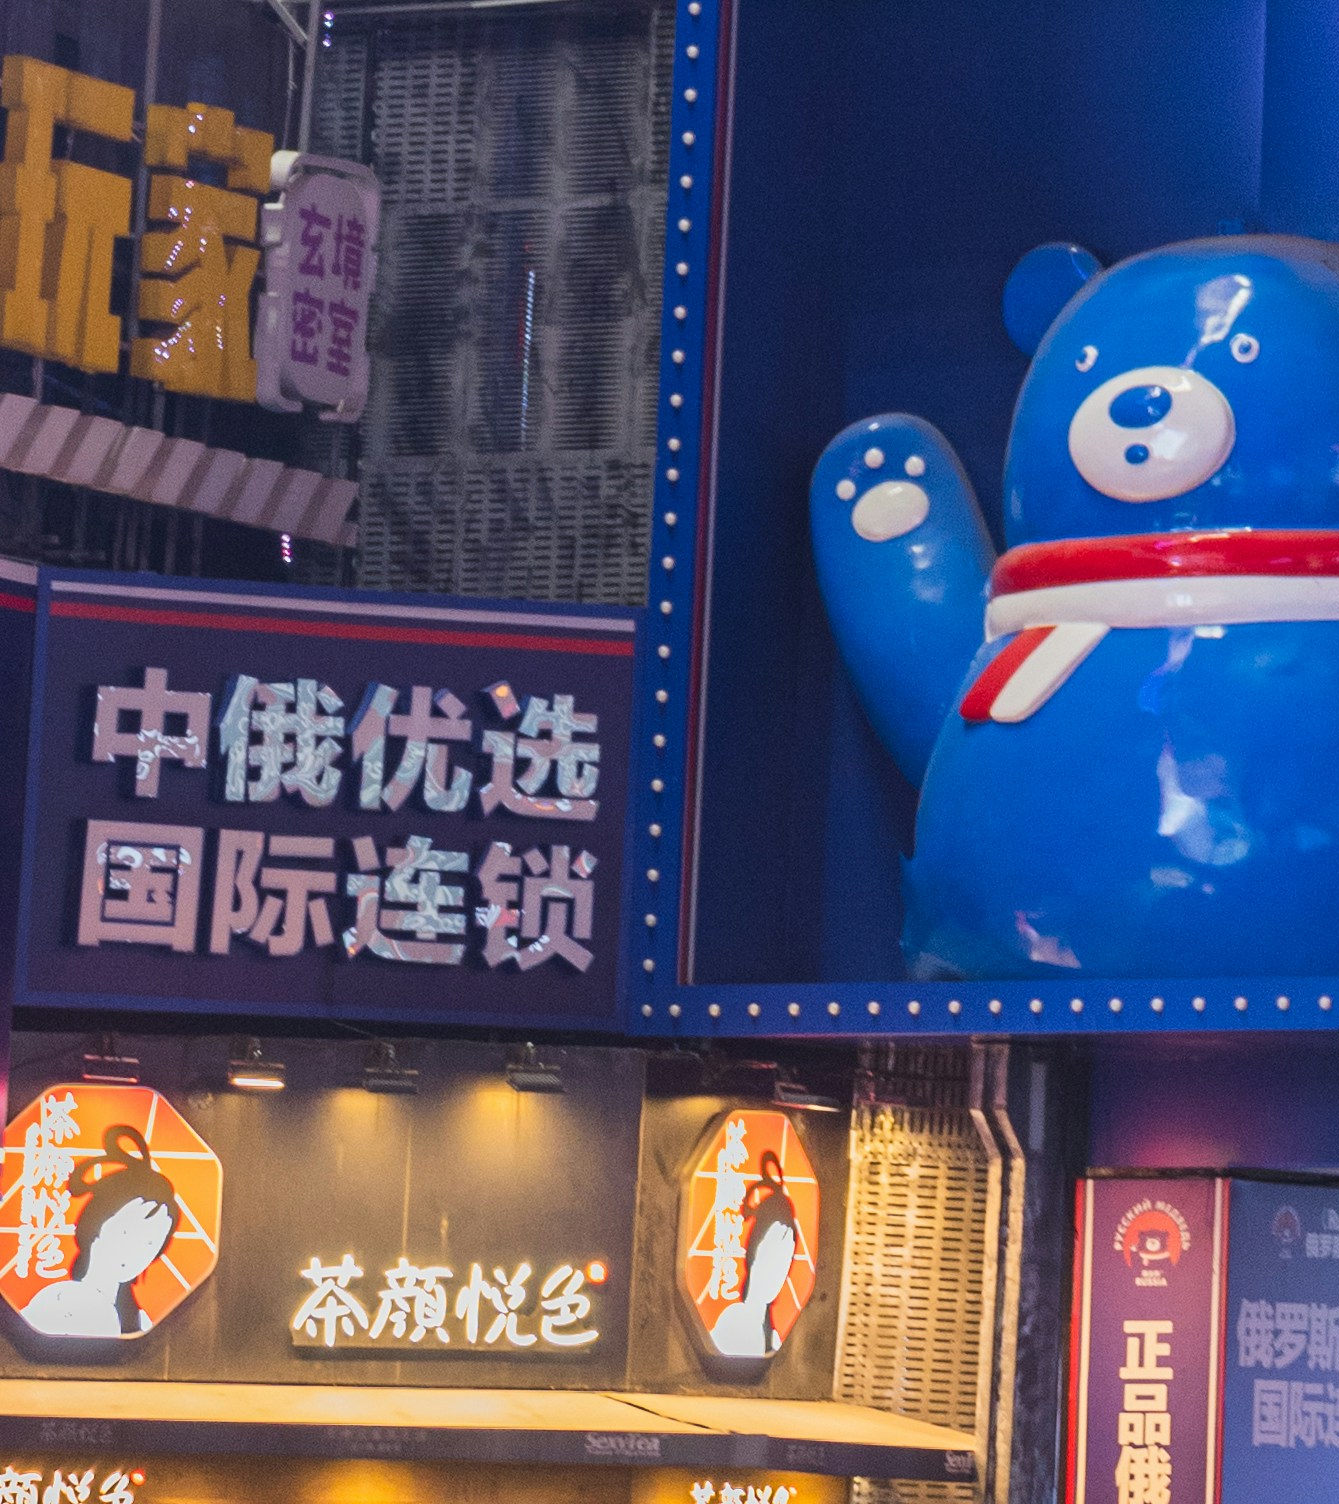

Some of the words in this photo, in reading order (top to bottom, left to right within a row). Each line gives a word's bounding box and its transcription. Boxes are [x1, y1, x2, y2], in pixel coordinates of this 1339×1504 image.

[91, 665, 600, 821] 中俄优选
[77, 819, 596, 972] 国际连锁
[292, 1253, 600, 1347] 茶颜悦色
